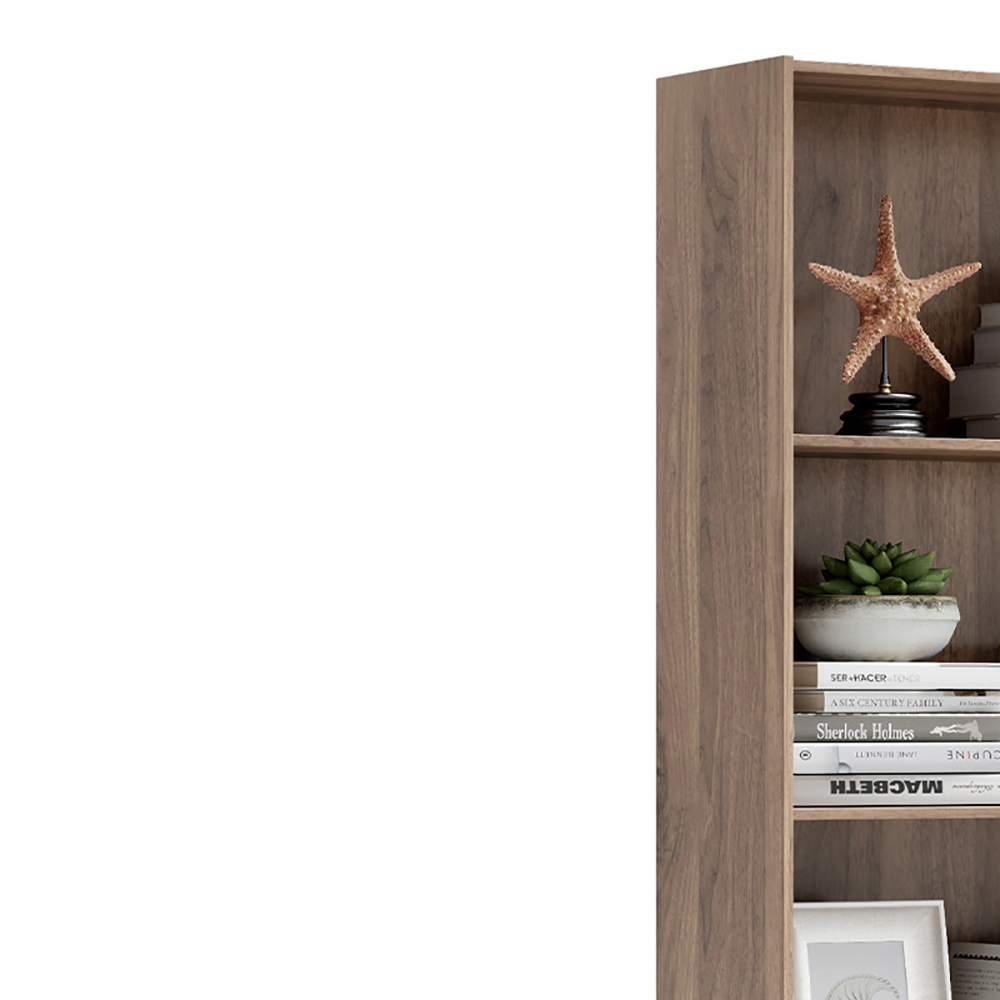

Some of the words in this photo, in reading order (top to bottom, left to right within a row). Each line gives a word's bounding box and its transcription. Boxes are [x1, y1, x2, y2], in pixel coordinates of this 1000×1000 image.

[830, 673, 848, 683] SER
[839, 699, 855, 707] SIX
[857, 699, 905, 707] CENTURY
[906, 699, 944, 707] FAMILY
[816, 723, 868, 740] Sherlock
[871, 724, 914, 740] Holmes
[830, 780, 943, 794] MACBETH
